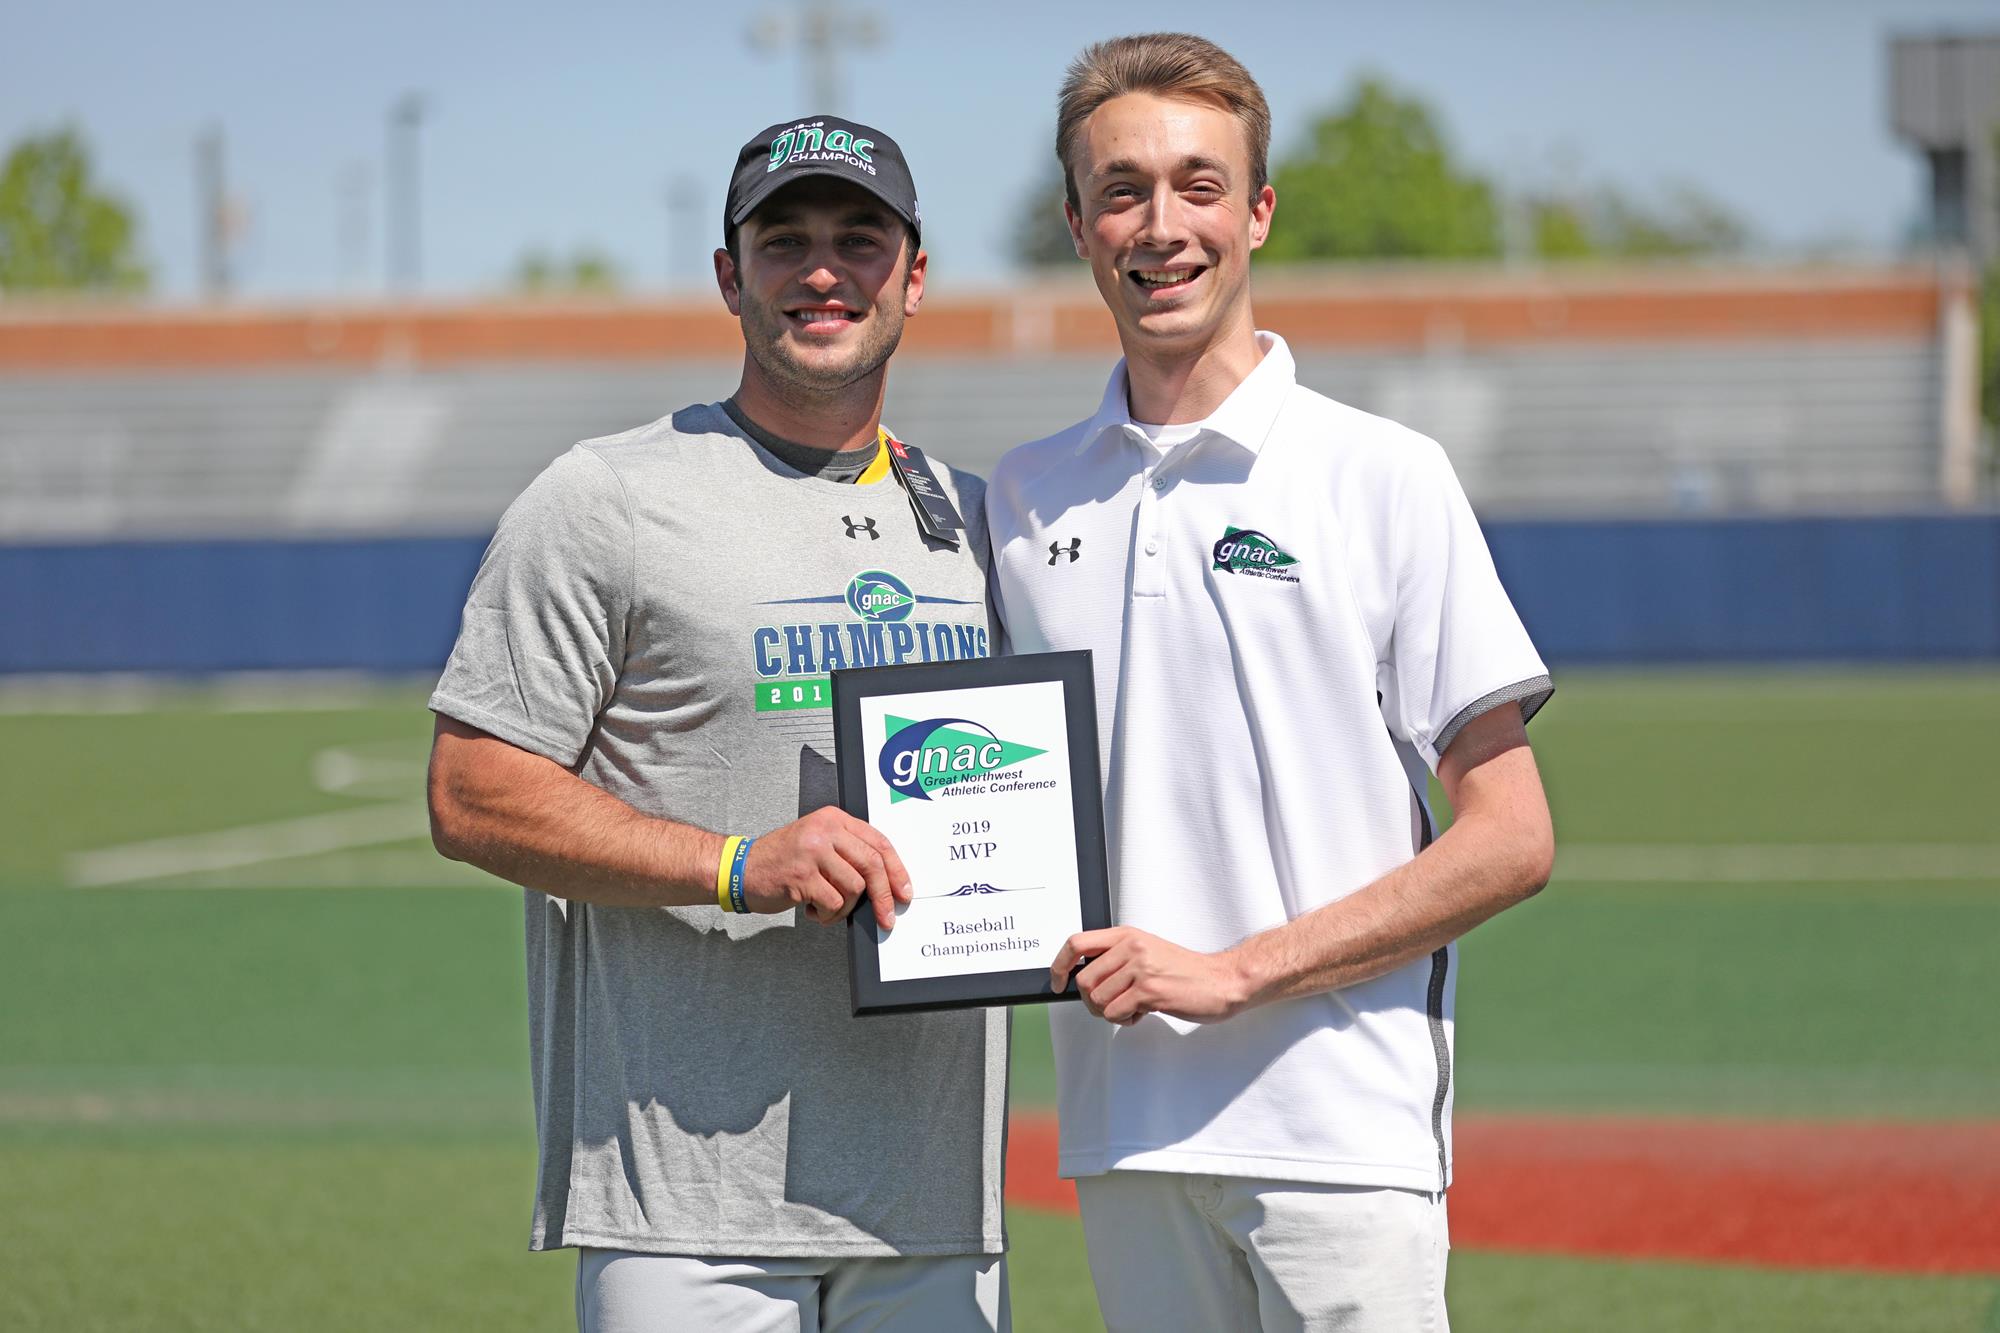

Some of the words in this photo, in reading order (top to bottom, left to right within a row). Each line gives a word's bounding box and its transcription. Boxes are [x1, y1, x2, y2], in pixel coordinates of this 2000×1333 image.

[767, 127, 875, 173] gnac
[788, 151, 877, 176] CHAMPIONS
[1217, 541, 1279, 565] gnac
[862, 591, 901, 610] gnac
[752, 621, 989, 678] CHAMPIONS
[771, 685, 822, 704] 201
[892, 741, 1003, 787] gnac
[924, 774, 957, 786] Great
[960, 769, 1023, 784] Northwest
[942, 783, 986, 797] Athletic
[990, 779, 1056, 793] Conference
[952, 820, 991, 835] 2019
[735, 843, 748, 862] THE
[948, 842, 997, 861] MVP
[943, 915, 1015, 936] Baseball
[921, 936, 1040, 957] Championships
